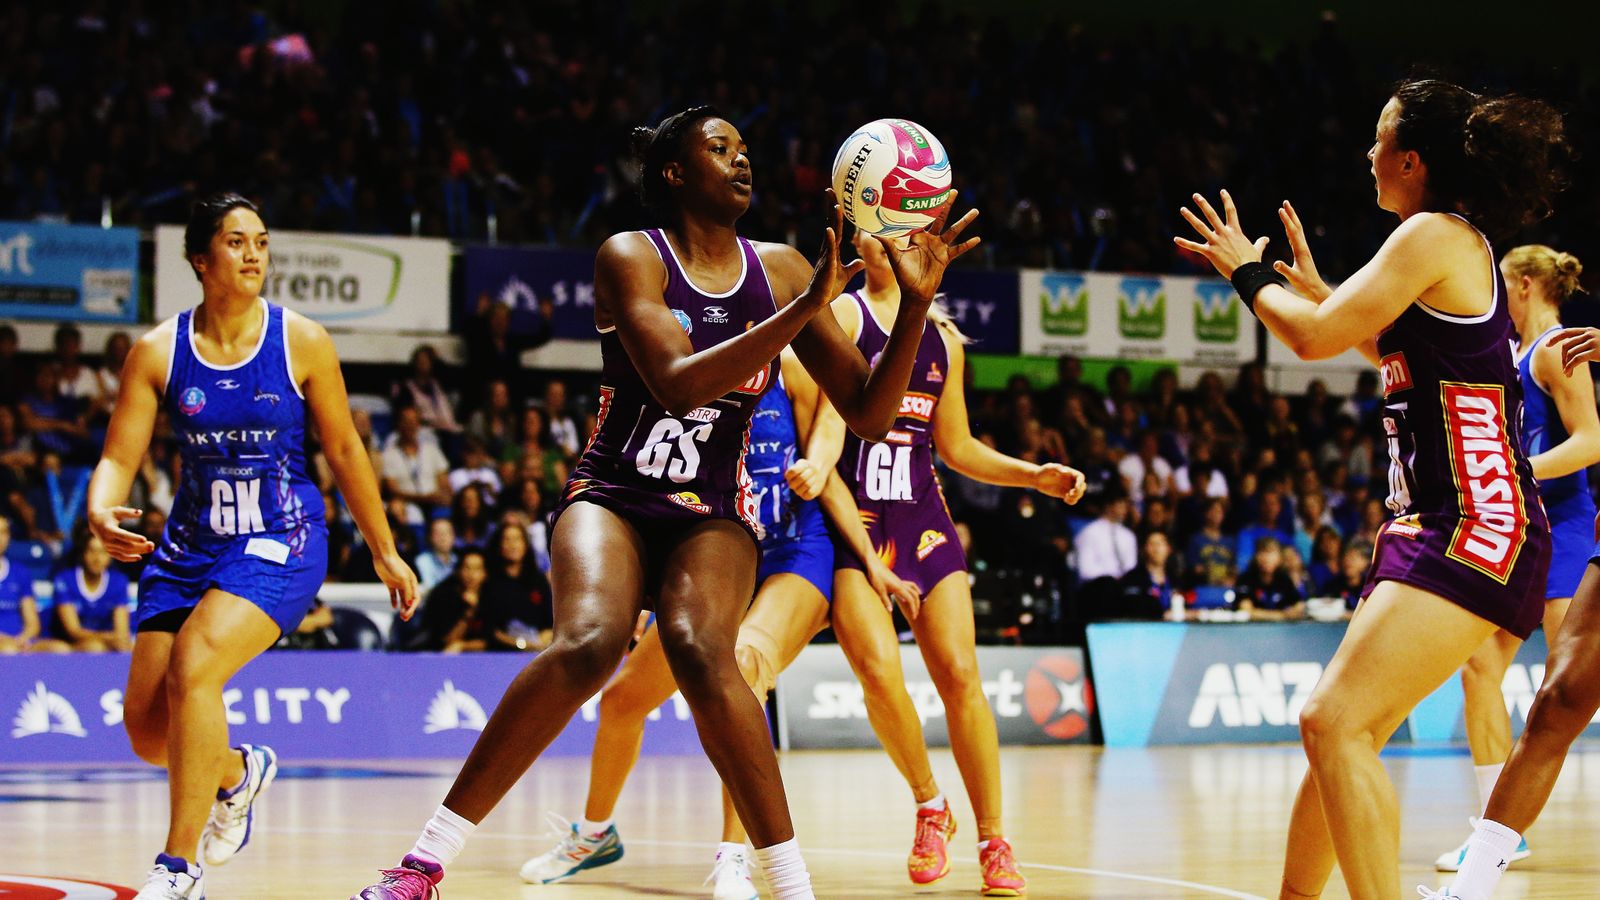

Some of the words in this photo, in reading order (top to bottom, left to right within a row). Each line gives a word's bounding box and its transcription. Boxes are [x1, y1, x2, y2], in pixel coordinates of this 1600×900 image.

[843, 143, 872, 223] GILBERT
[905, 198, 928, 210] SAN
[702, 316, 729, 324] SCODY
[187, 429, 278, 445] SKYCITY
[635, 417, 714, 484] GS
[865, 442, 914, 501] GA
[209, 478, 267, 536] GK
[100, 686, 351, 727] SCITY
